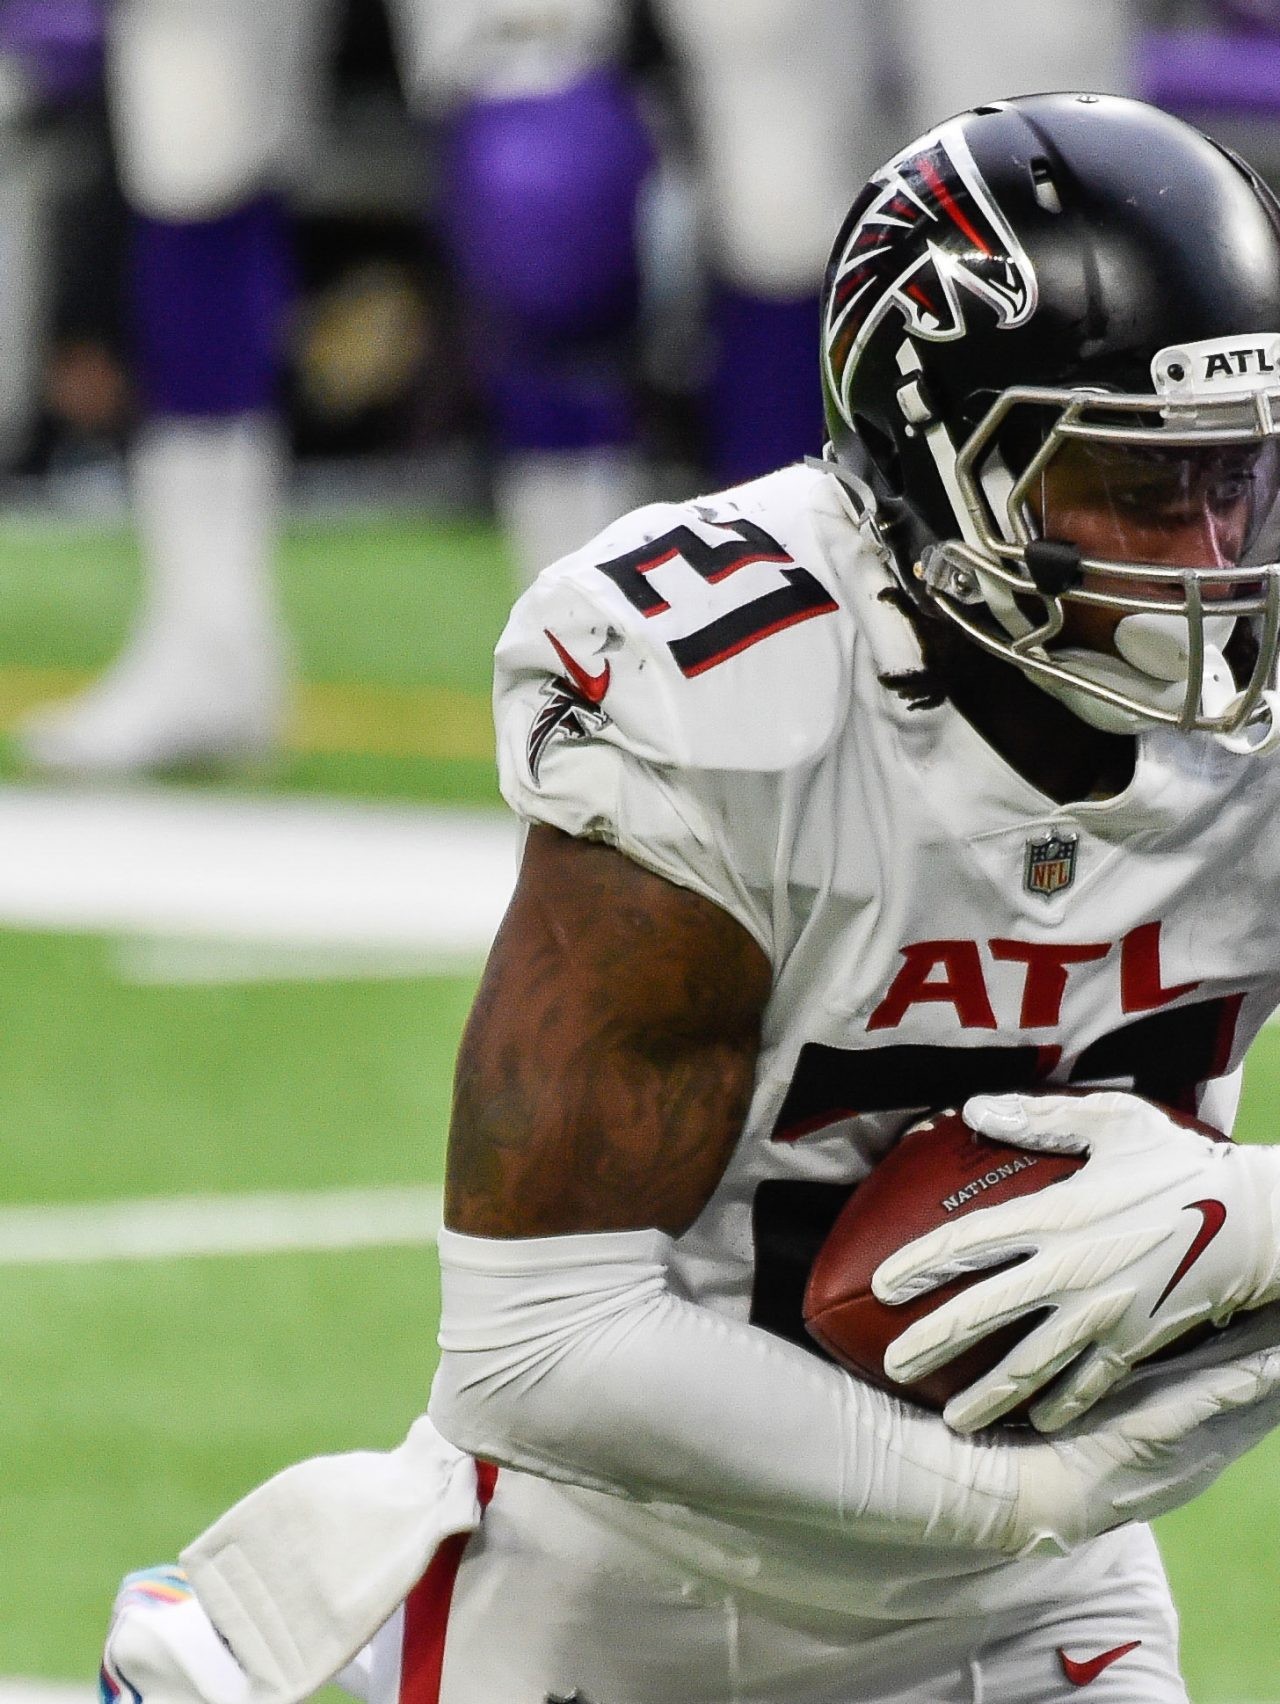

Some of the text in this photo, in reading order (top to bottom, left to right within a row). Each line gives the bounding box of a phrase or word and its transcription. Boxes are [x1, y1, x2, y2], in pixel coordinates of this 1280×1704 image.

[1204, 348, 1276, 380] ATL
[595, 517, 841, 679] 21
[1032, 860, 1070, 890] NFL
[866, 920, 1200, 1033] ATL
[940, 1155, 1038, 1213] NATIONAL
